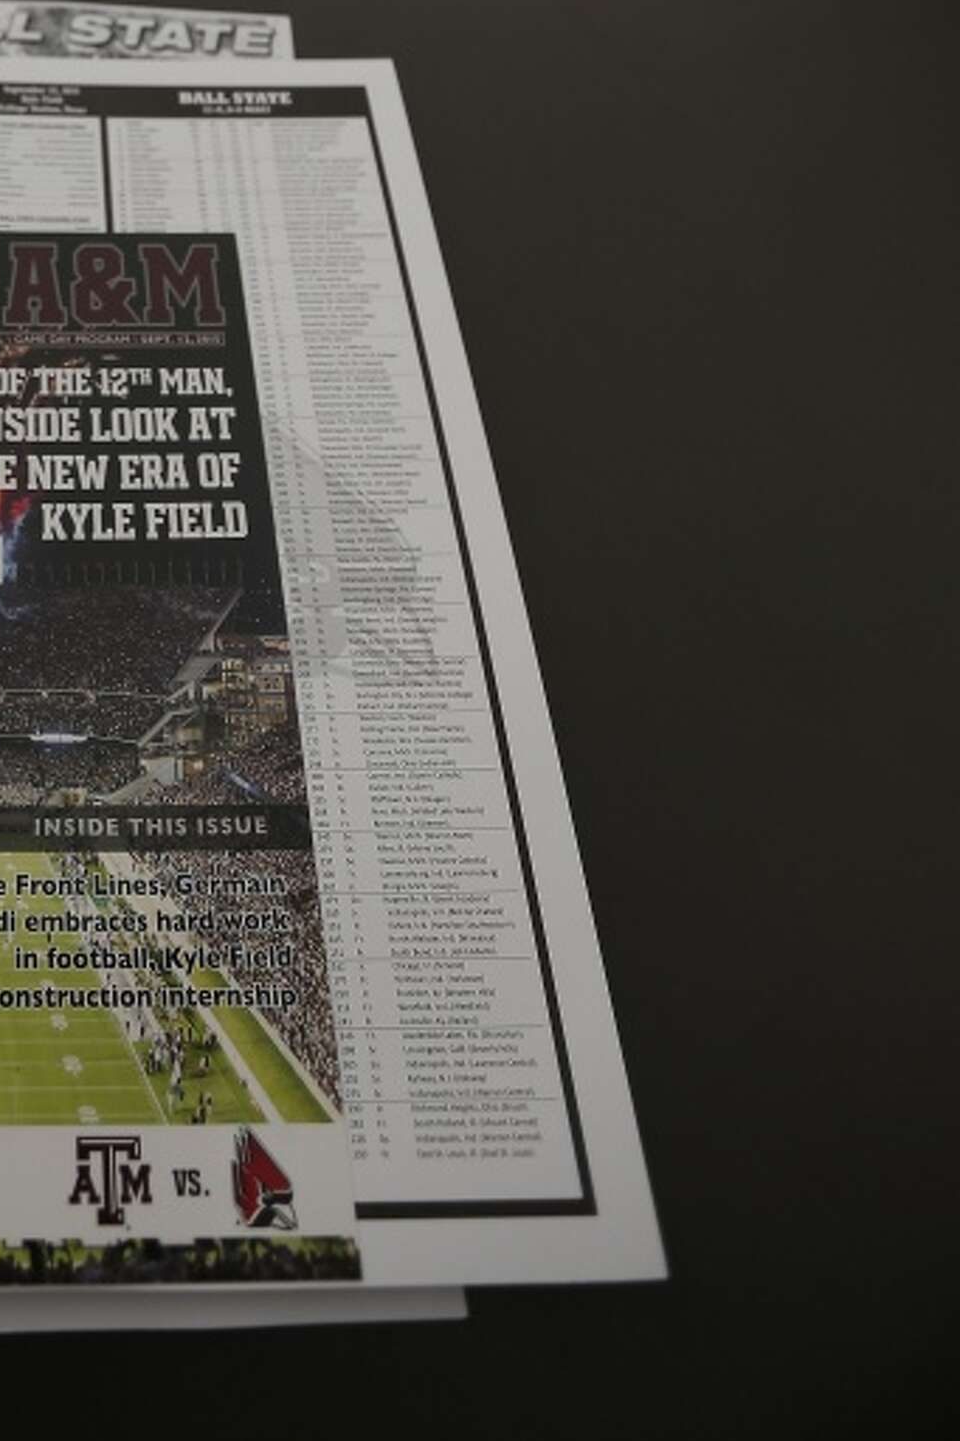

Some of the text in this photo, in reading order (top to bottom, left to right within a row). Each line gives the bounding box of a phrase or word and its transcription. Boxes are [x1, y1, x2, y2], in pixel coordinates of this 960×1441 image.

[68, 14, 276, 57] STATE
[178, 92, 292, 106] BALL STATE
[2, 240, 226, 327] A&M
[36, 367, 91, 396] THE
[98, 367, 152, 396] 12TH
[159, 367, 232, 398] MAN,
[90, 407, 178, 442] LOOK
[189, 407, 236, 442] AT
[27, 455, 108, 490] NEW
[118, 455, 190, 490] ERA
[198, 453, 240, 489] OF
[41, 501, 249, 540] KYLE FIELD
[34, 815, 268, 837] INSIDE THIS ISSUE
[16, 874, 84, 896] Front
[175, 874, 285, 896] Germain
[25, 910, 147, 932] embraces
[157, 910, 214, 932] hard
[223, 910, 290, 932] work
[15, 946, 38, 969] in
[164, 946, 220, 976] Kyle
[230, 946, 291, 969] Field
[161, 984, 295, 1014] internship
